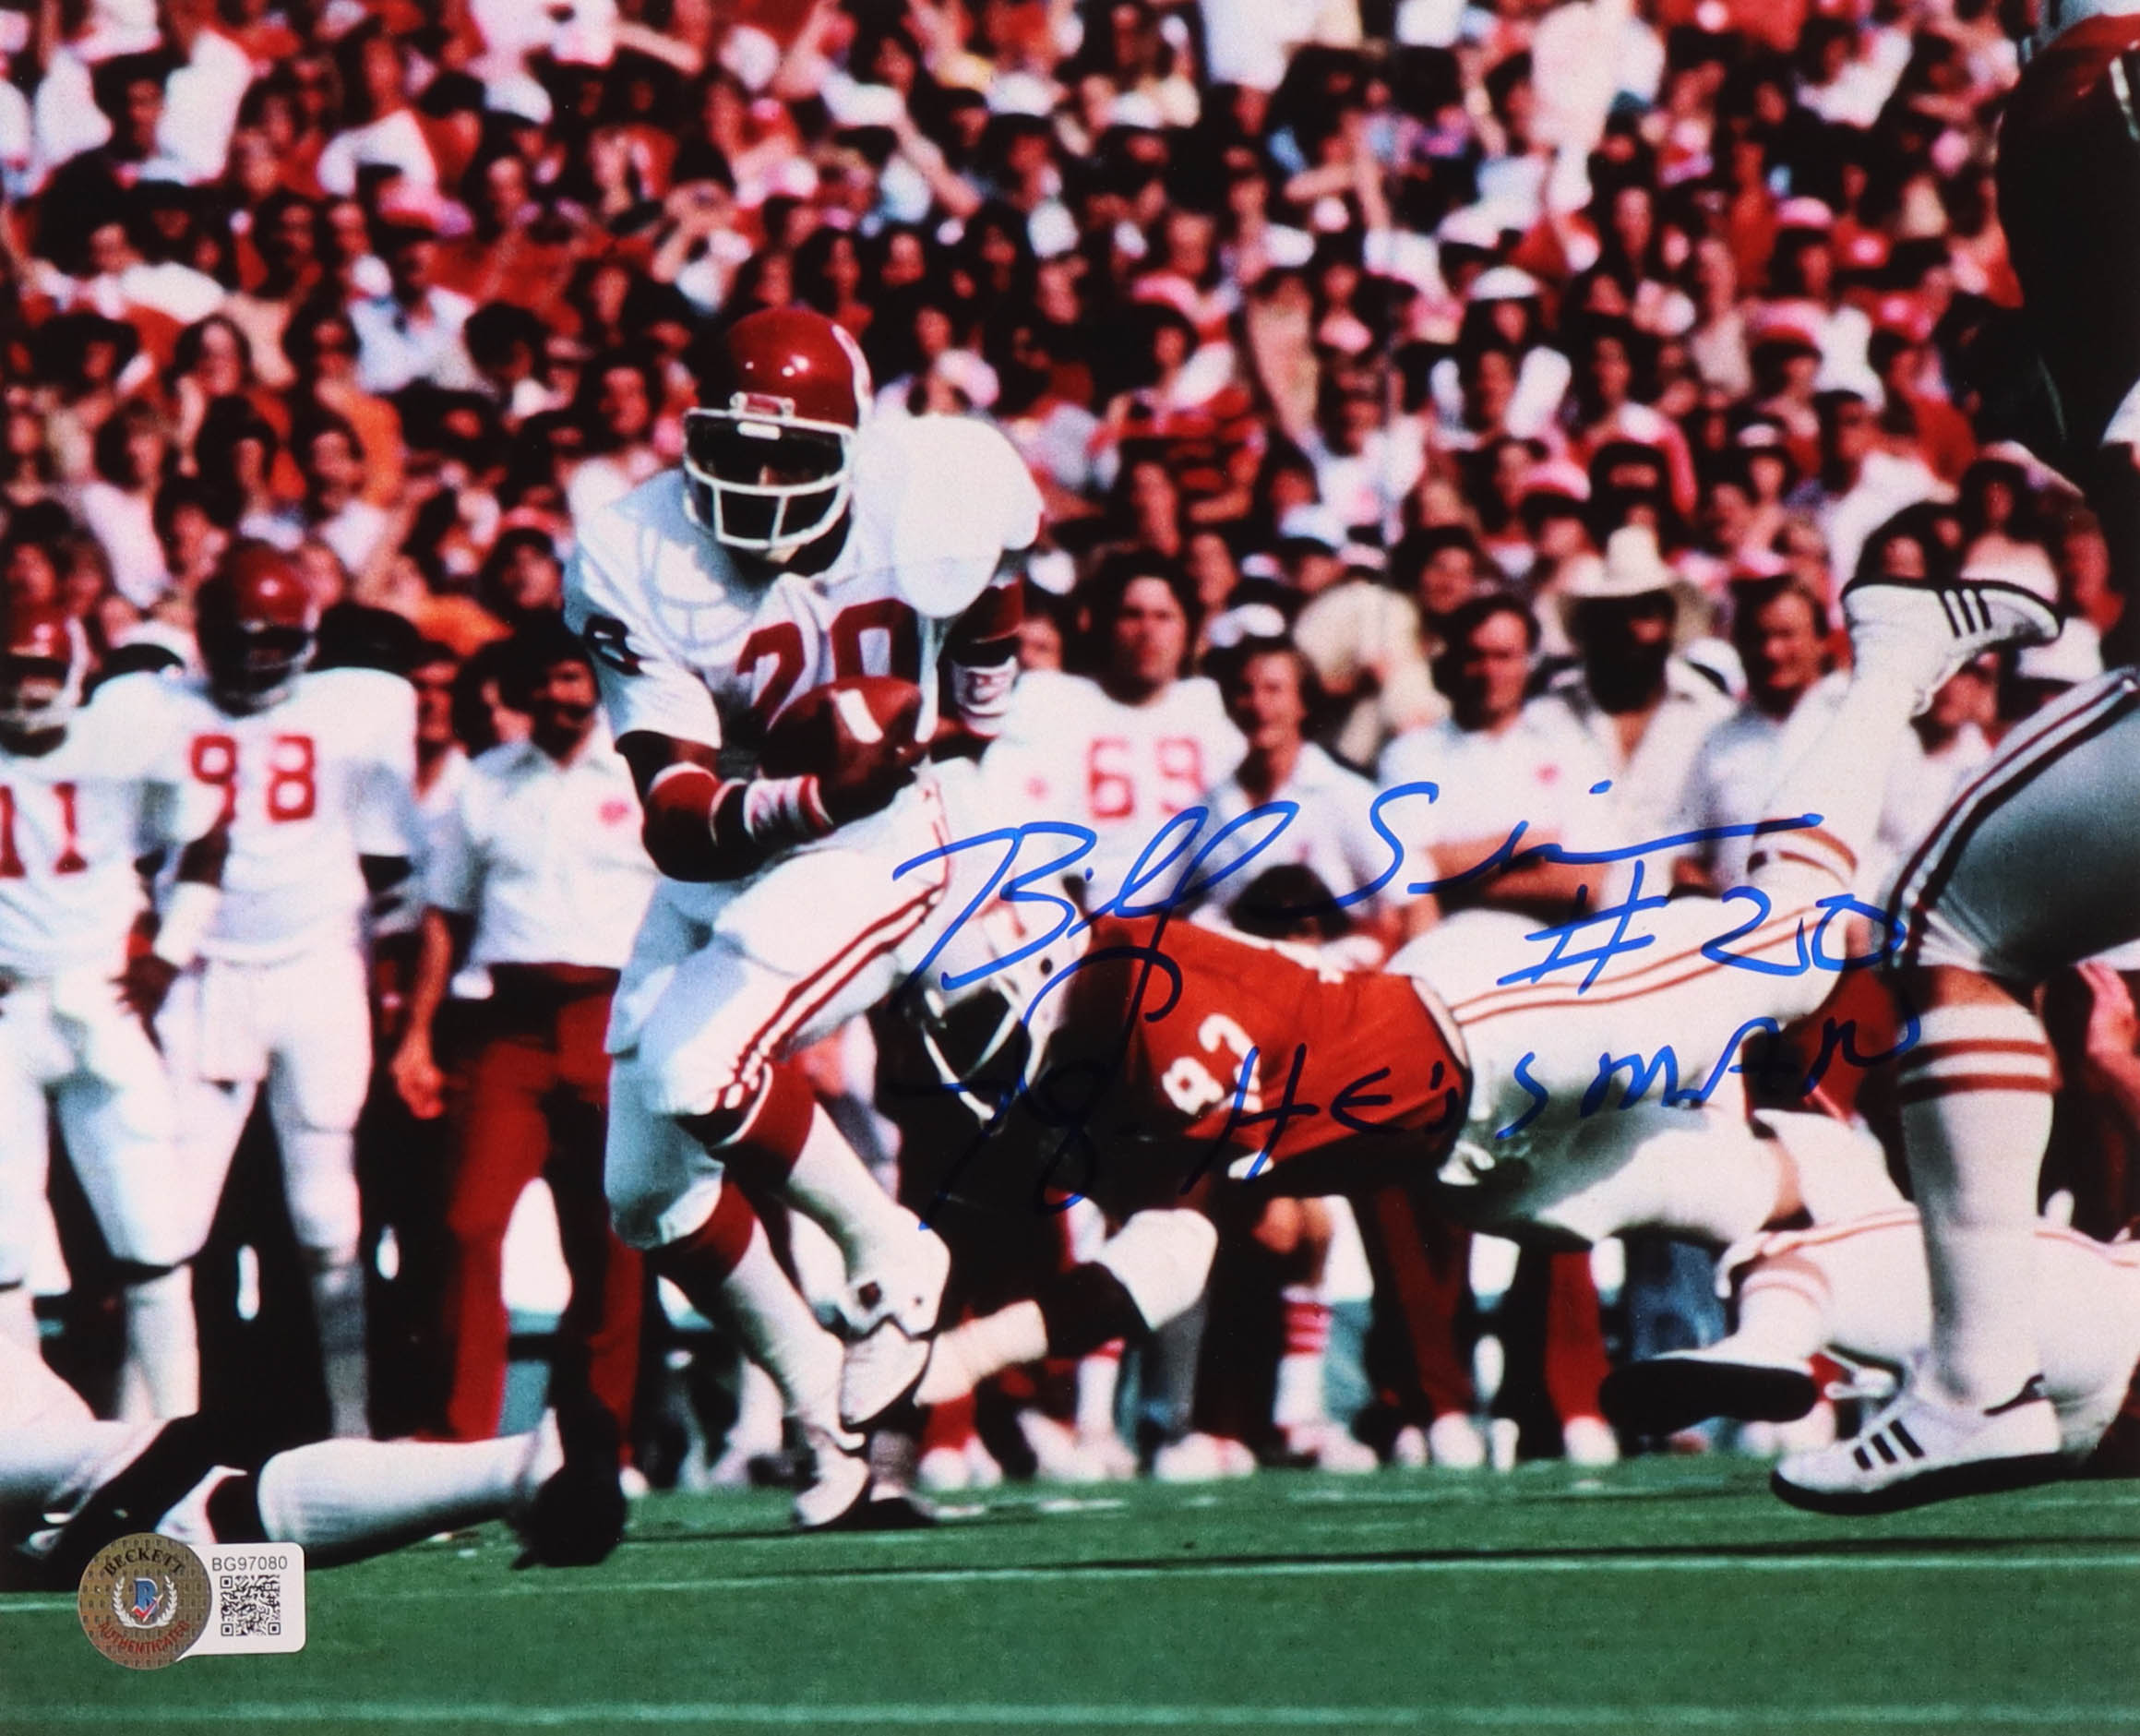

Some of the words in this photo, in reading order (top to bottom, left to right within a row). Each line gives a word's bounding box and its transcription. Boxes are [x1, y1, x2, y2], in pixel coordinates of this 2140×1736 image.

[735, 598, 921, 730] 20
[190, 735, 316, 823] 98
[1087, 736, 1205, 820] 69
[103, 1548, 186, 1574] BECKETT
[211, 1556, 288, 1572] BG97080
[98, 1620, 190, 1655] AUTHENTICATED
